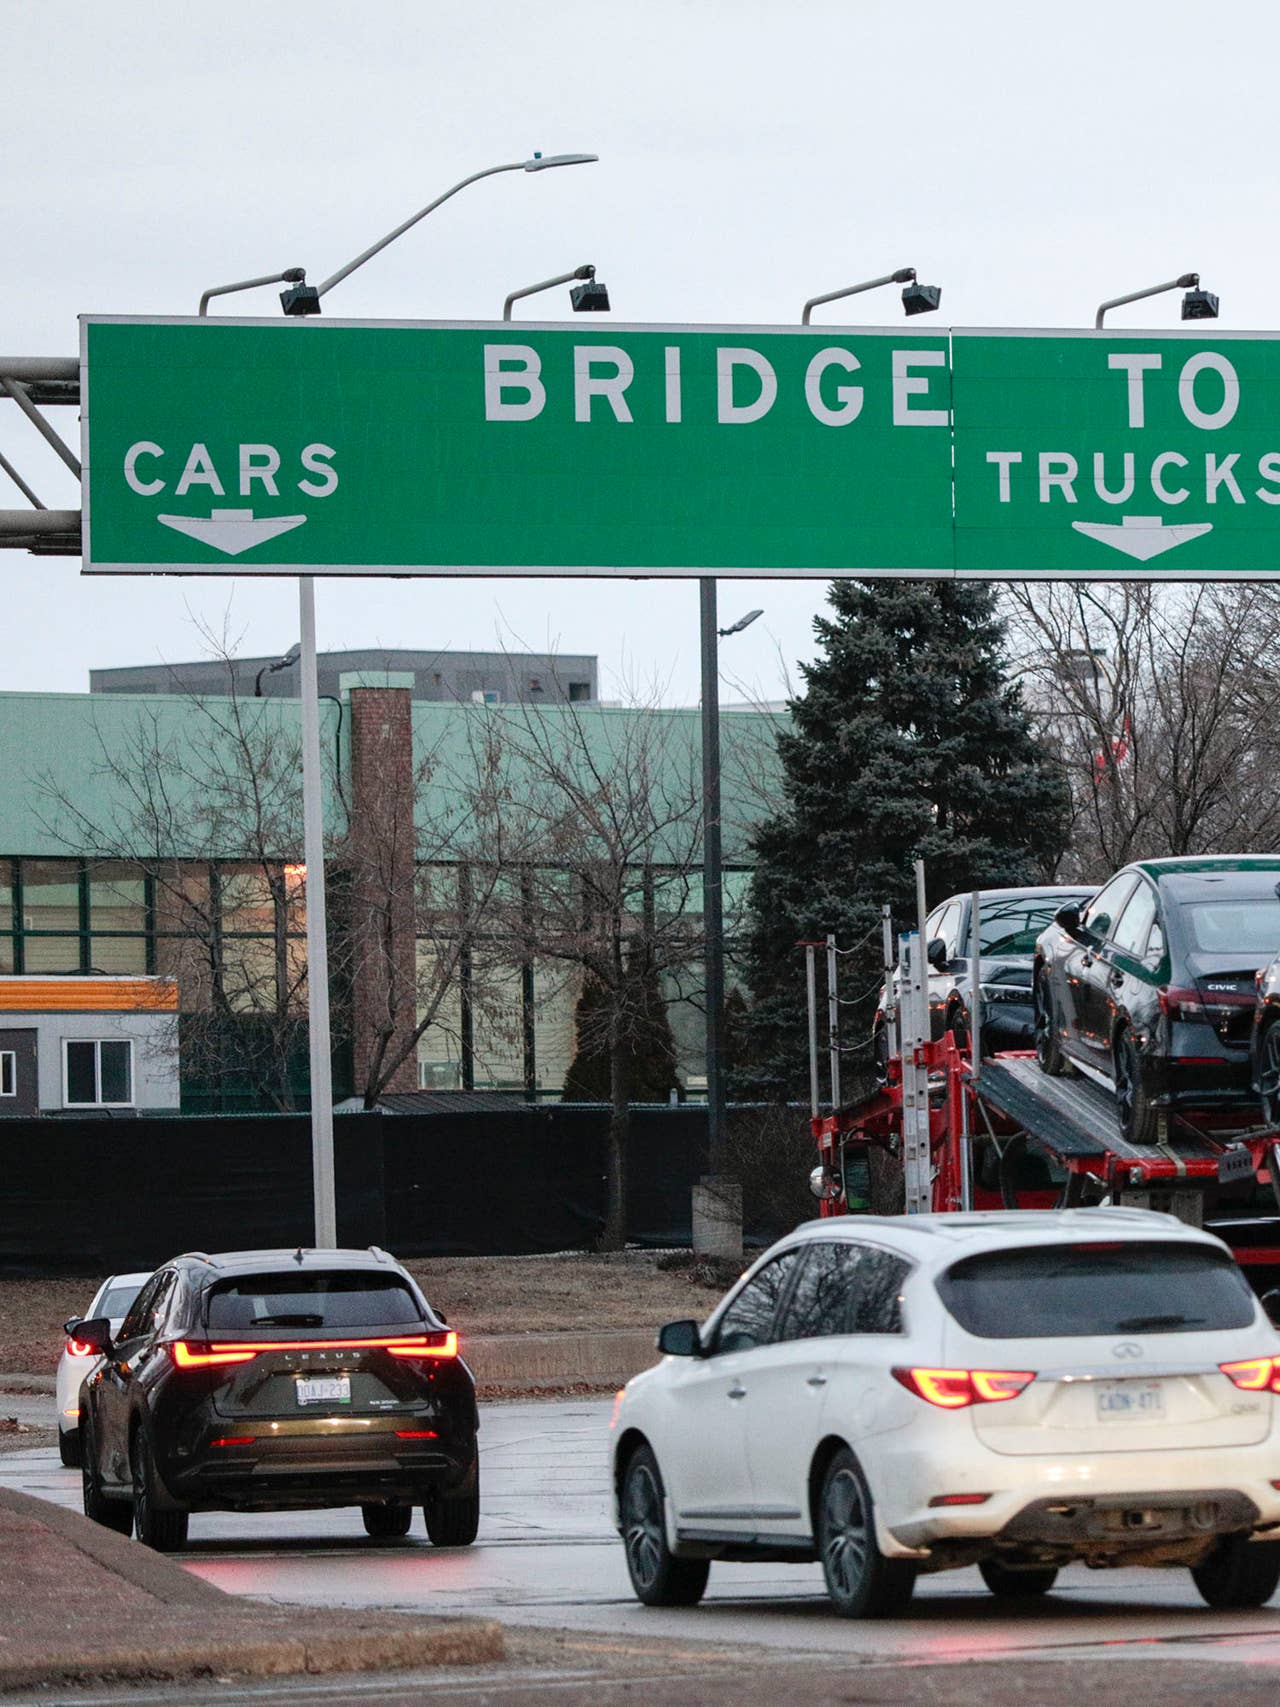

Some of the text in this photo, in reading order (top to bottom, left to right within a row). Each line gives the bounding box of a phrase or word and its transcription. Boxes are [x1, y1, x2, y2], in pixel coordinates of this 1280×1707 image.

[485, 345, 948, 426] BRIDGE
[1109, 352, 1239, 429] TO
[125, 442, 338, 496] CARS
[1207, 983, 1238, 991] CIVIC
[284, 1352, 360, 1360] LEXUS
